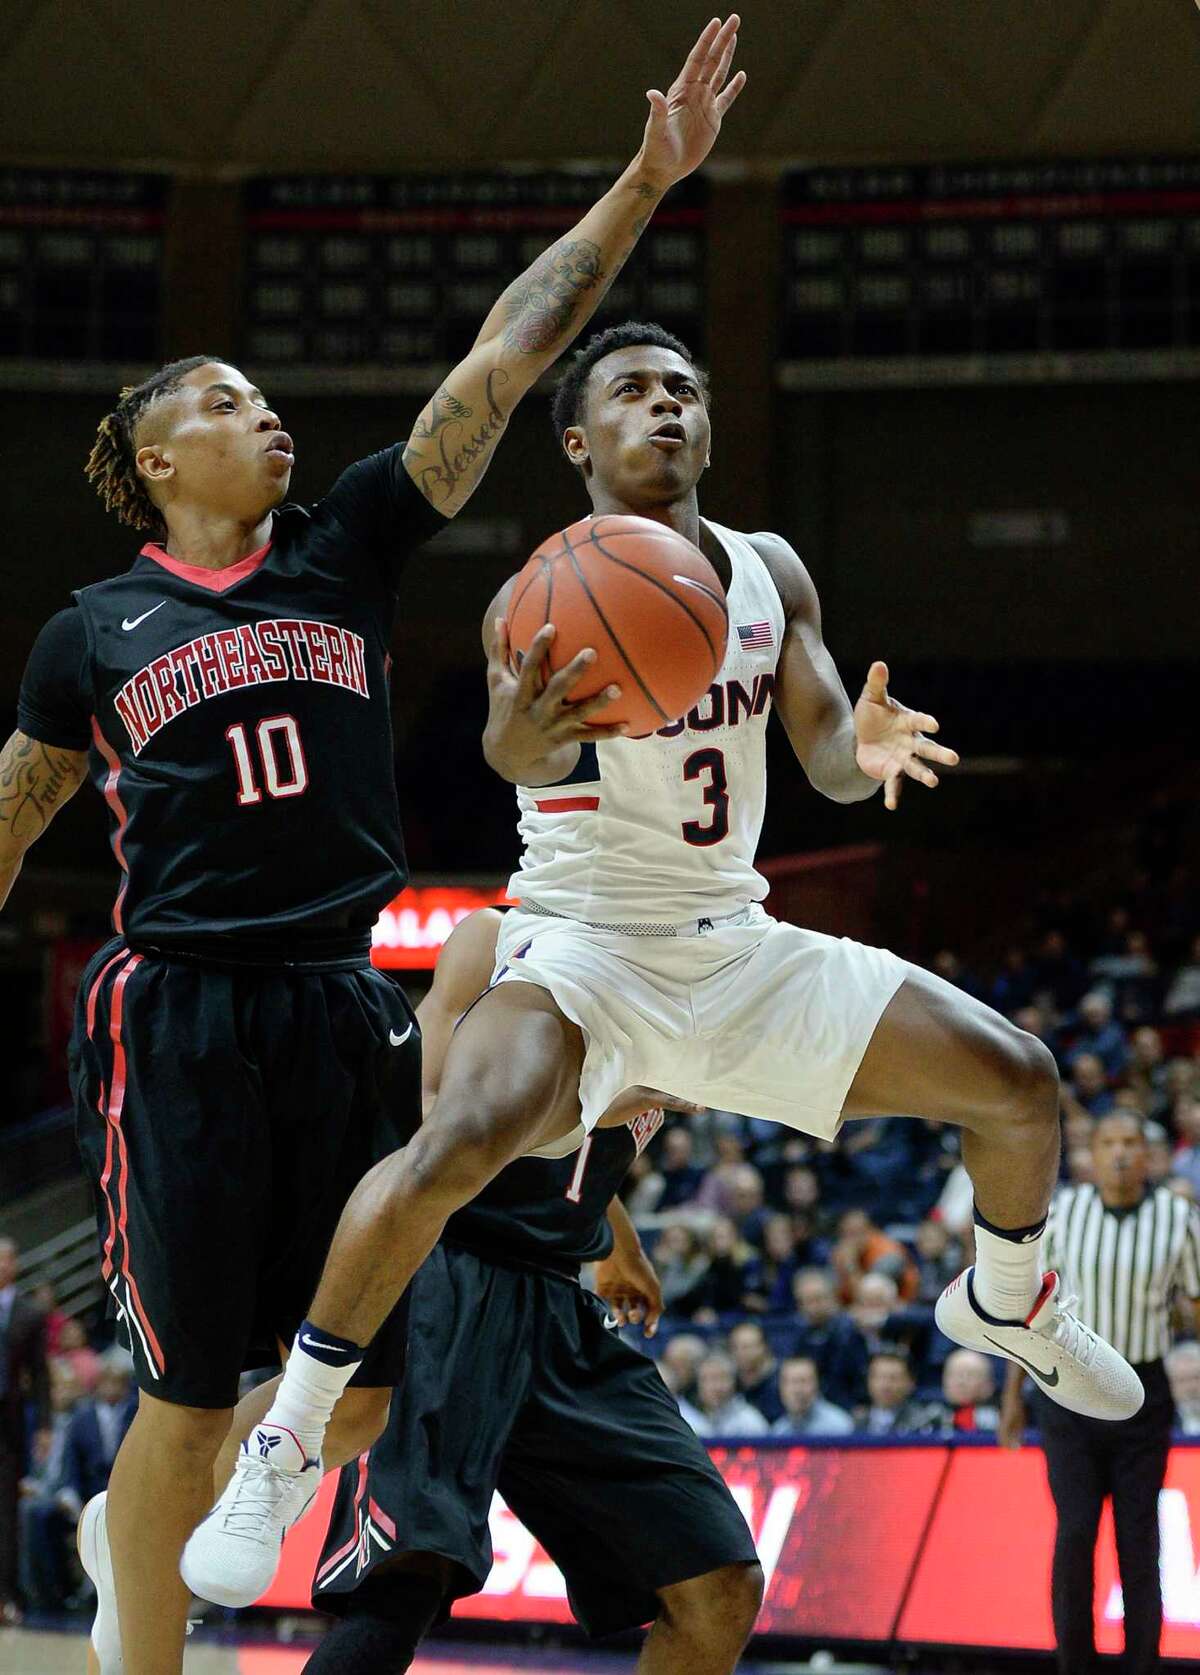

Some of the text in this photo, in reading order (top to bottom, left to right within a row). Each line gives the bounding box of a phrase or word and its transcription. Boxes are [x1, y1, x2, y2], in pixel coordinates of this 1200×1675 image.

[418, 367, 509, 502] Blessed
[113, 619, 370, 758] NORTHEASTERN
[225, 713, 309, 806] 10
[681, 747, 730, 848] 3
